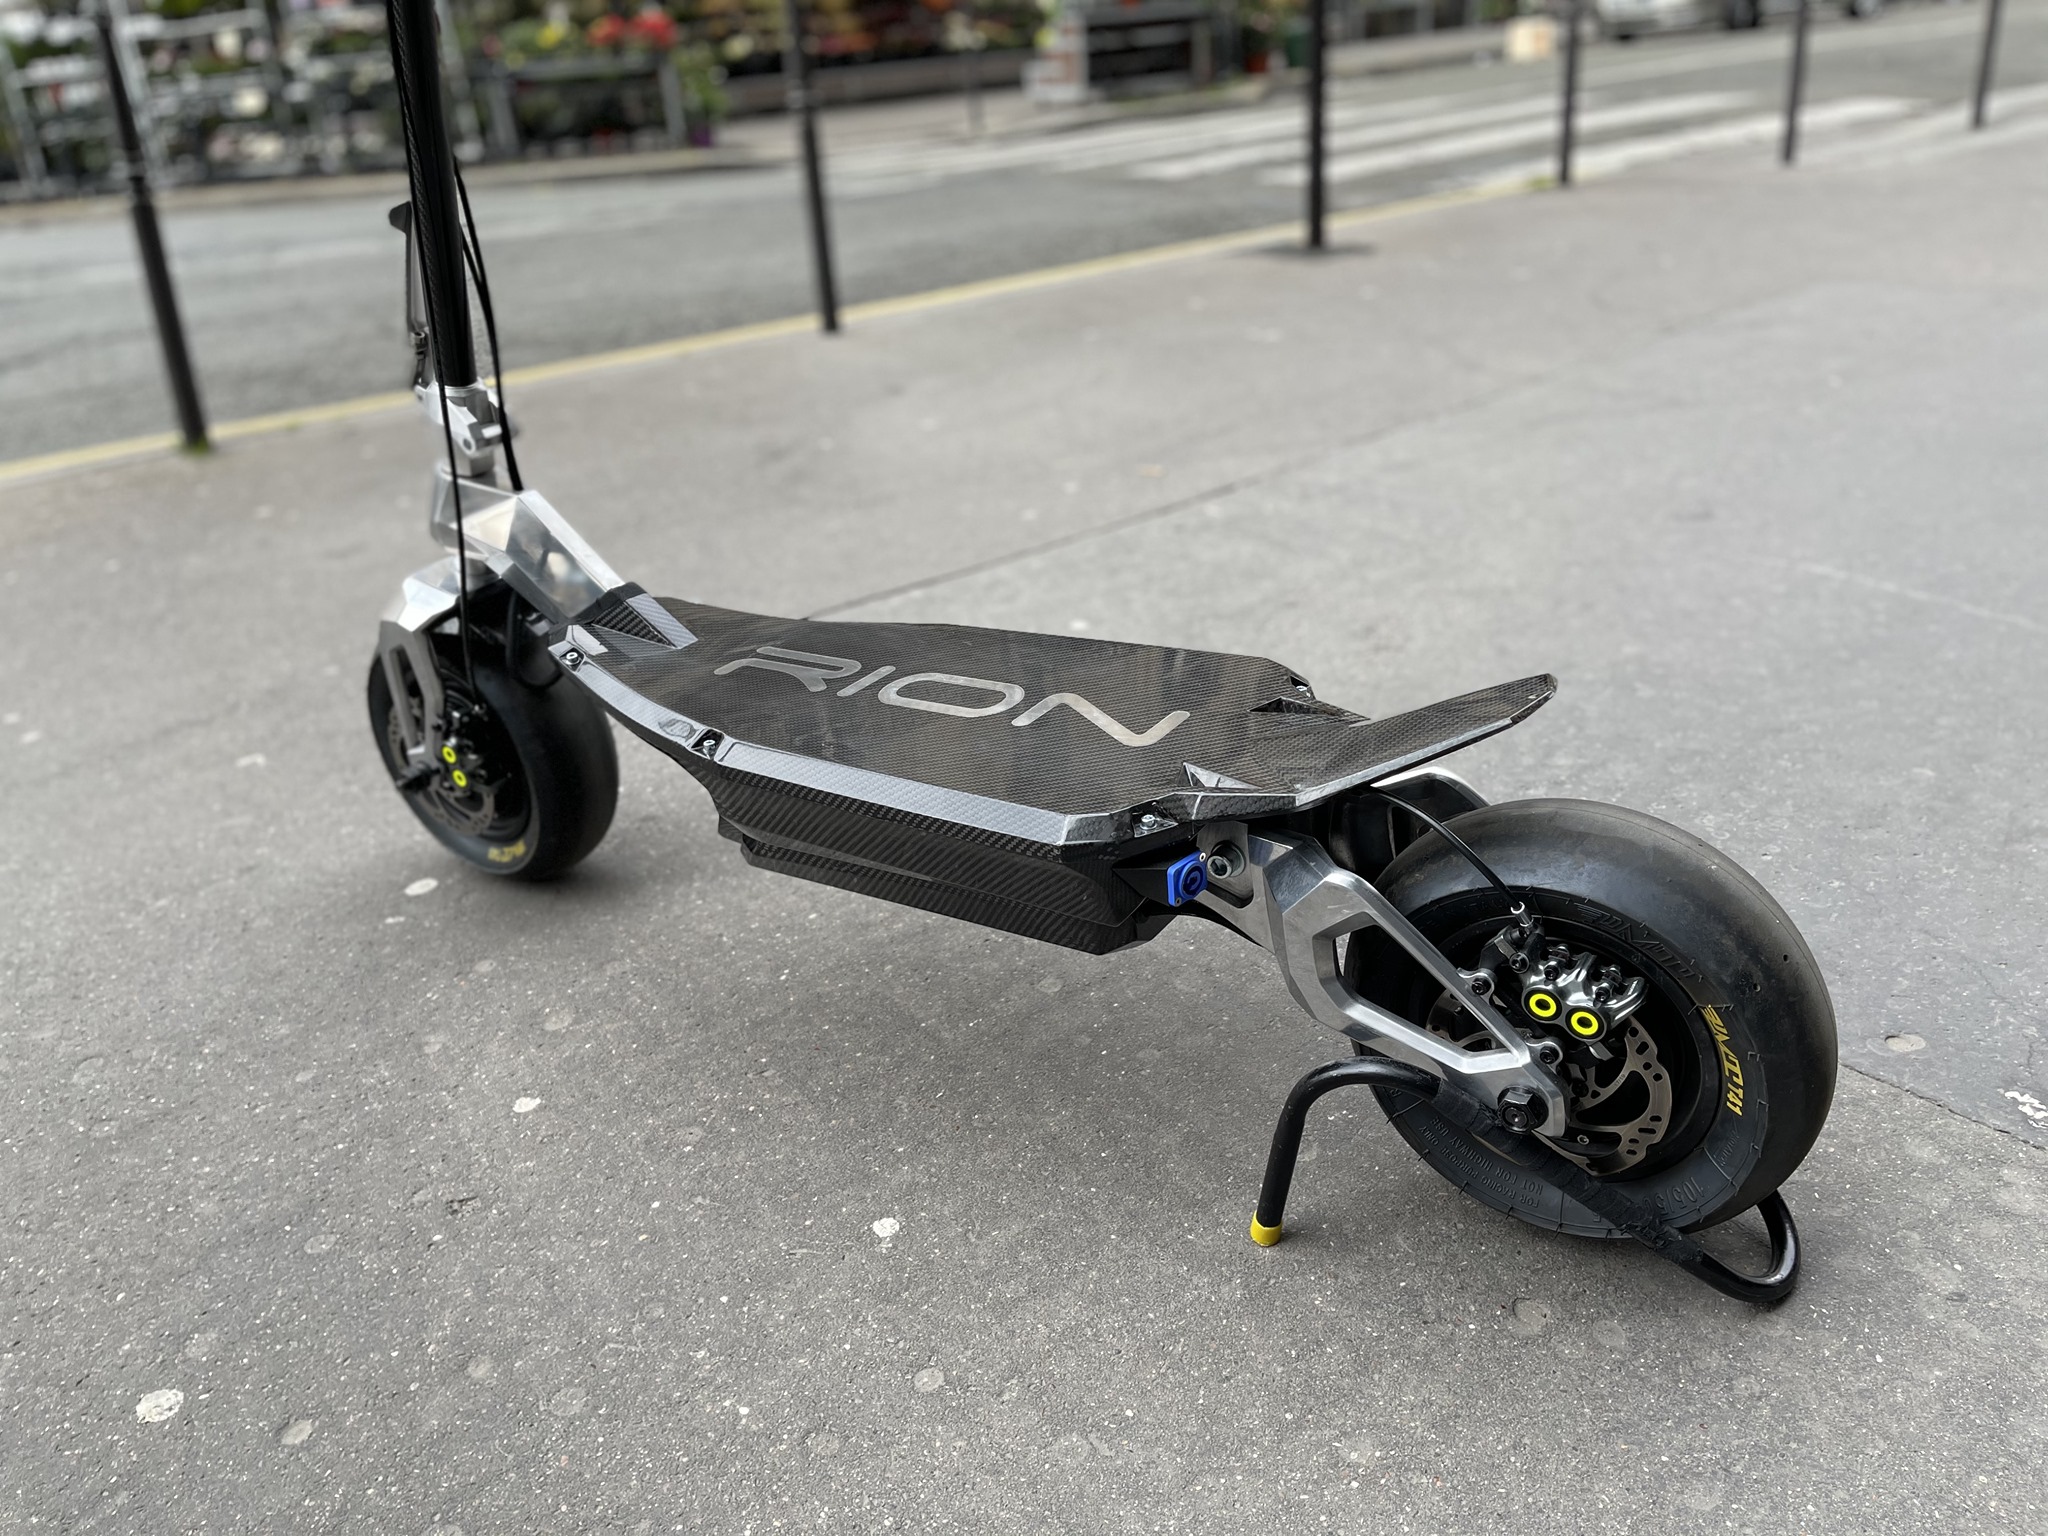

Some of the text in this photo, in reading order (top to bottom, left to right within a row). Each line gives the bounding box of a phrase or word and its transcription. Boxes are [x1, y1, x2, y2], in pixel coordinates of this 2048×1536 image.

[713, 645, 1191, 747] RION
[1726, 1082, 1744, 1117] T41
[1418, 1125, 1541, 1208] FOR RACING PURPOSE ONLY
[1429, 1116, 1544, 1196] NOT FOR HIGHWAY USE
